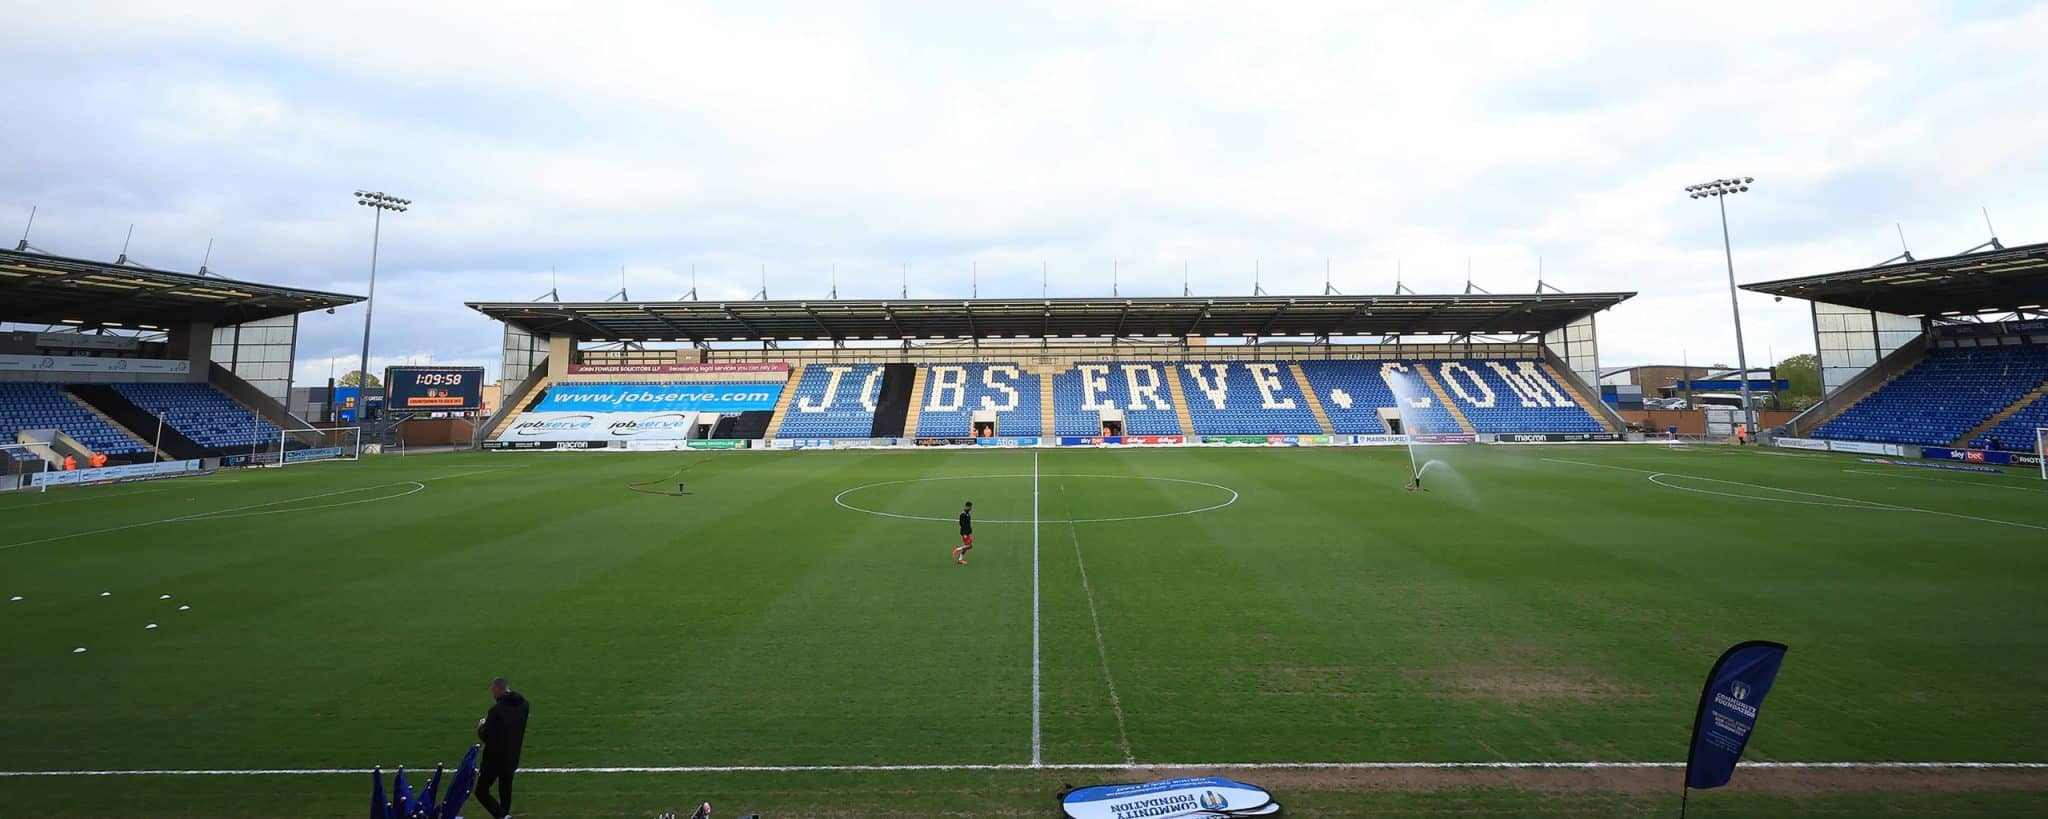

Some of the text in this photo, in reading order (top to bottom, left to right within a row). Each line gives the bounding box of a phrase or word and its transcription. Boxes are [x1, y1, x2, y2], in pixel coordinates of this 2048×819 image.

[415, 374, 462, 385] 1:09:58
[554, 391, 769, 405] www.jobserve.com
[514, 419, 592, 430] jobserve
[608, 418, 685, 430] jobserve
[1514, 433, 1547, 442] macron
[556, 440, 589, 449] macron
[1950, 450, 1982, 460] sky bet
[1715, 697, 1756, 719] FOUNDATION
[1716, 692, 1757, 713] COMMUNITY
[1110, 794, 1196, 812] FOUNDATION
[1117, 801, 1198, 819] COMMUNITY
